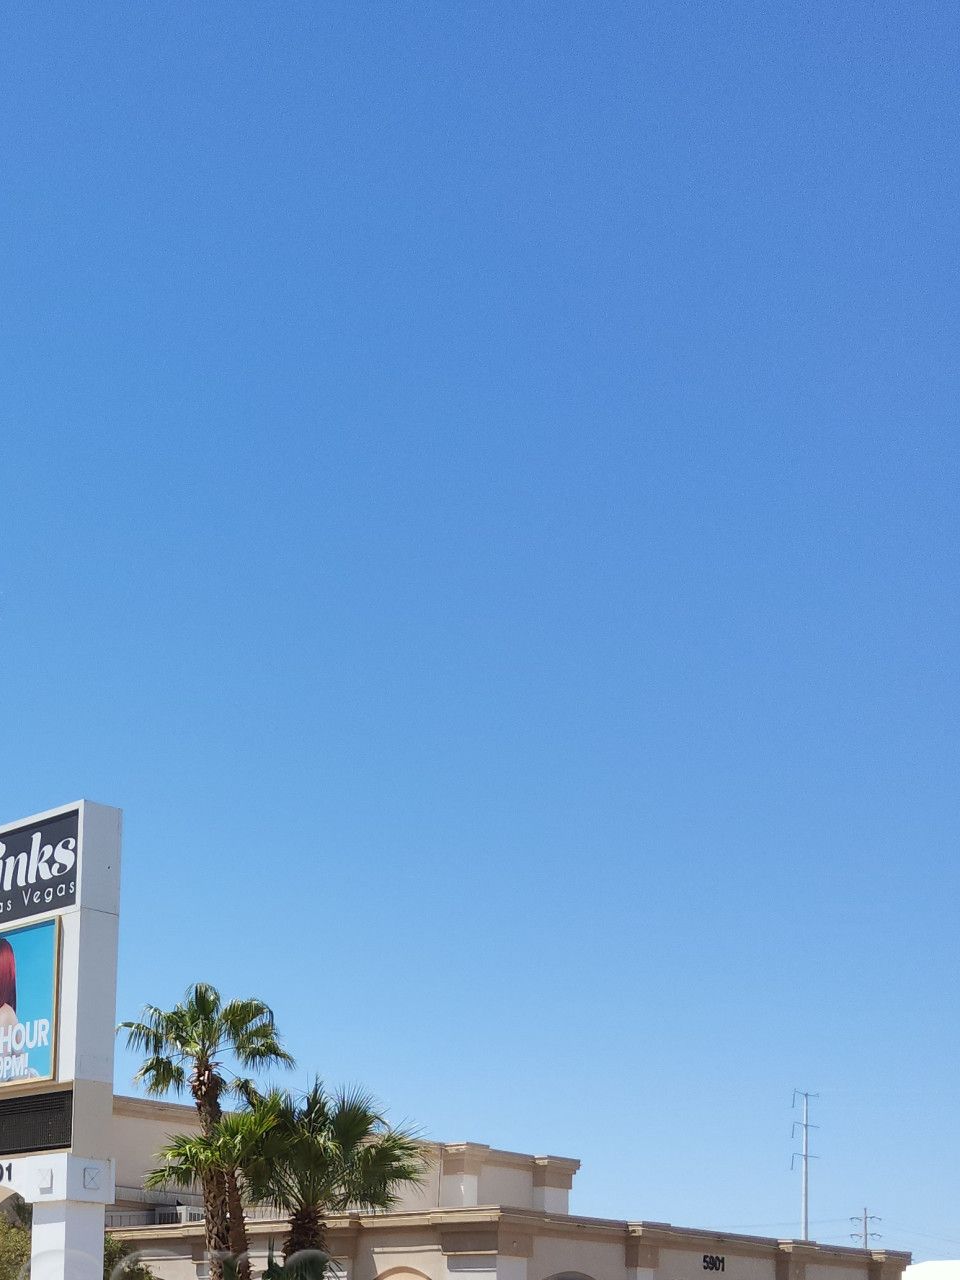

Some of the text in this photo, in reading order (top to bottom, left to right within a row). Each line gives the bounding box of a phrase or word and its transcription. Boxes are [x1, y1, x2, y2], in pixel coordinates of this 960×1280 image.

[22, 881, 75, 907] Vegas
[0, 1018, 50, 1054] HOUR
[702, 1254, 725, 1272] 5901
